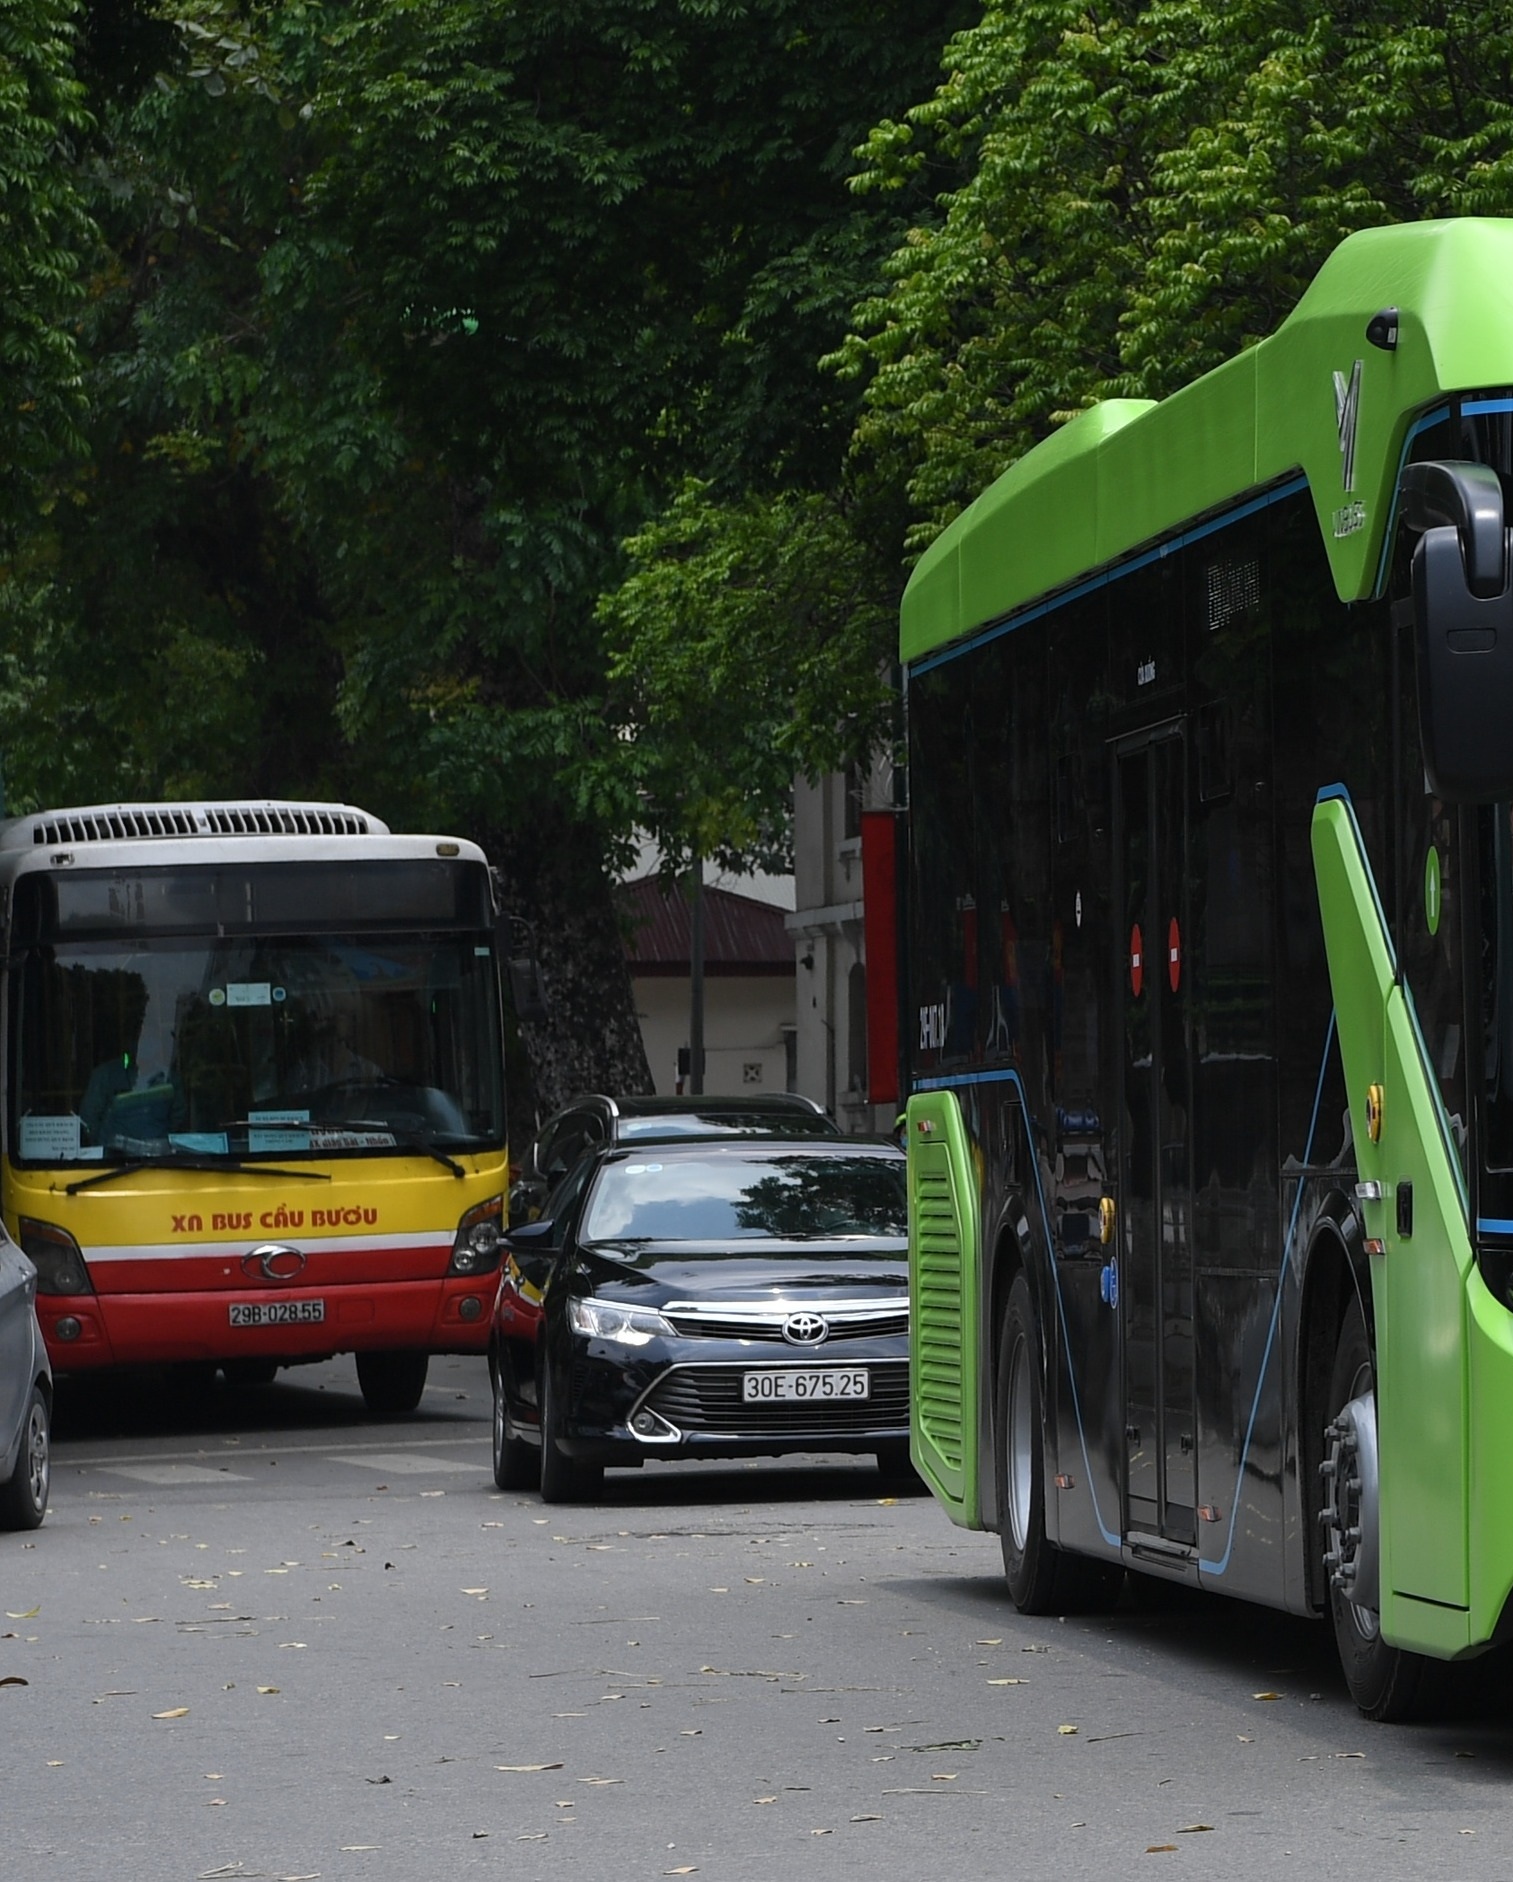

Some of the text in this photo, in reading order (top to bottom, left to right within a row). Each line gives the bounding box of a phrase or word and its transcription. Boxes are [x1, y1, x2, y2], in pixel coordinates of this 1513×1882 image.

[212, 1212, 253, 1231] BUS
[259, 1203, 304, 1229] CẦU
[747, 1373, 865, 1399] 30E-675.25
